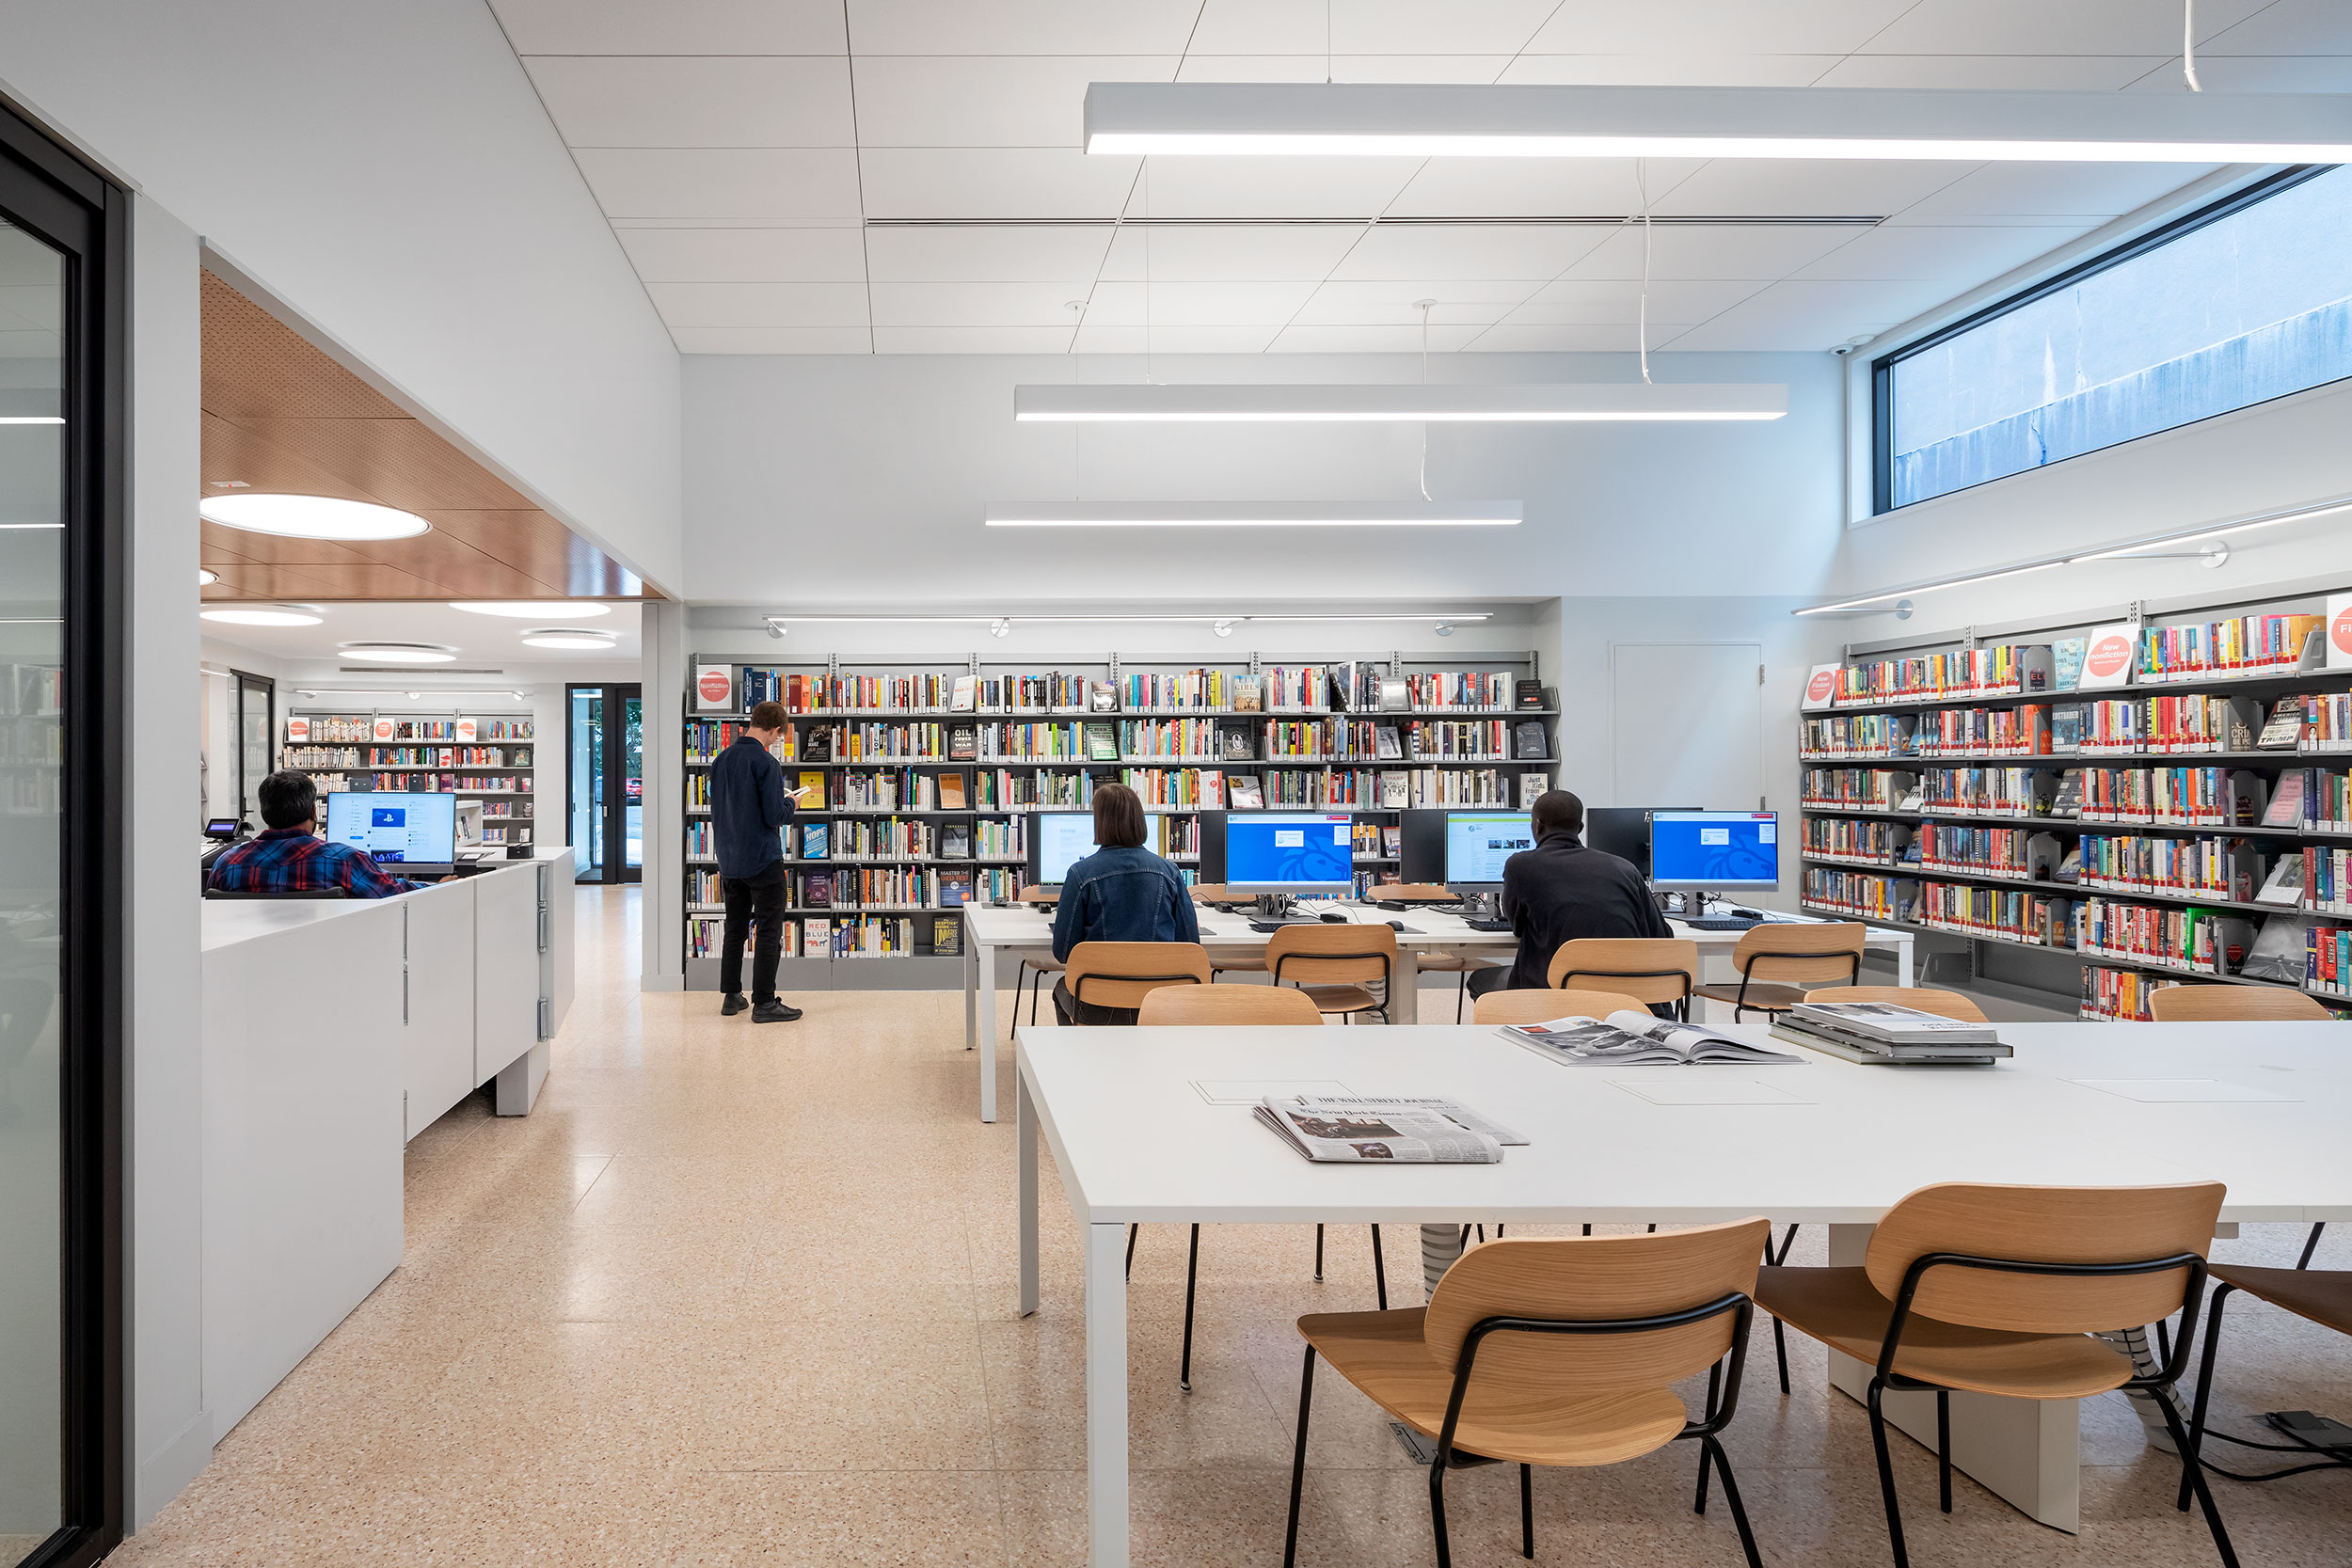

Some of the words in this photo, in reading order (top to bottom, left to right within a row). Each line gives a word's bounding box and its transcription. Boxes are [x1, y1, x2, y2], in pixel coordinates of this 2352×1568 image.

[2340, 625, 2352, 634] Fi
[2102, 643, 2120, 652] New
[2090, 651, 2129, 660] nonfiction
[806, 827, 826, 843] HOPE
[934, 928, 958, 946] UNIVERSE
